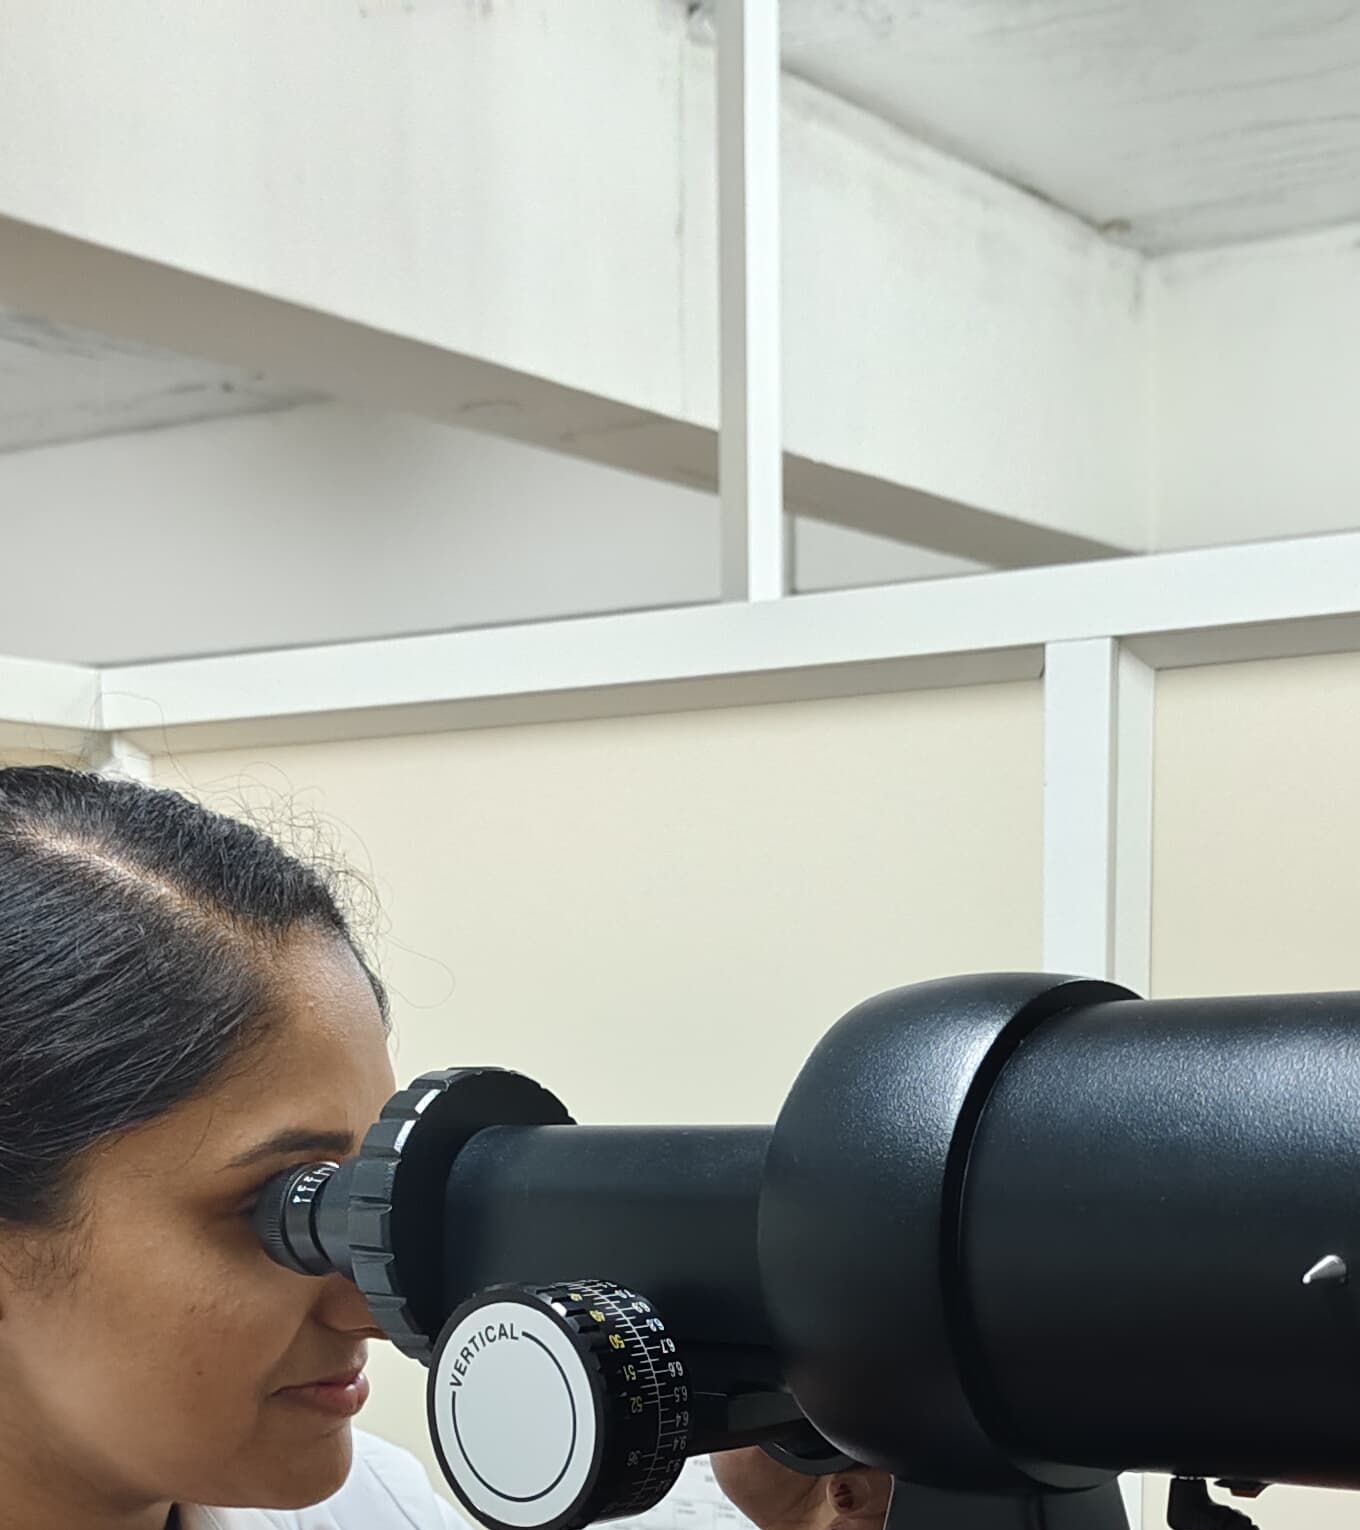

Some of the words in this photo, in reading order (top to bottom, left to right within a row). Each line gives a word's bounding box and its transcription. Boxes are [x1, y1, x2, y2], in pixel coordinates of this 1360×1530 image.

[609, 1334, 625, 1349] 50
[660, 1338, 676, 1353] 6.7
[449, 1322, 520, 1388] VERTICAL
[623, 1364, 637, 1380] 51
[668, 1361, 683, 1377] 6.6
[674, 1386, 688, 1402] 6.5
[630, 1396, 643, 1413] 52
[676, 1411, 689, 1427] 6.4
